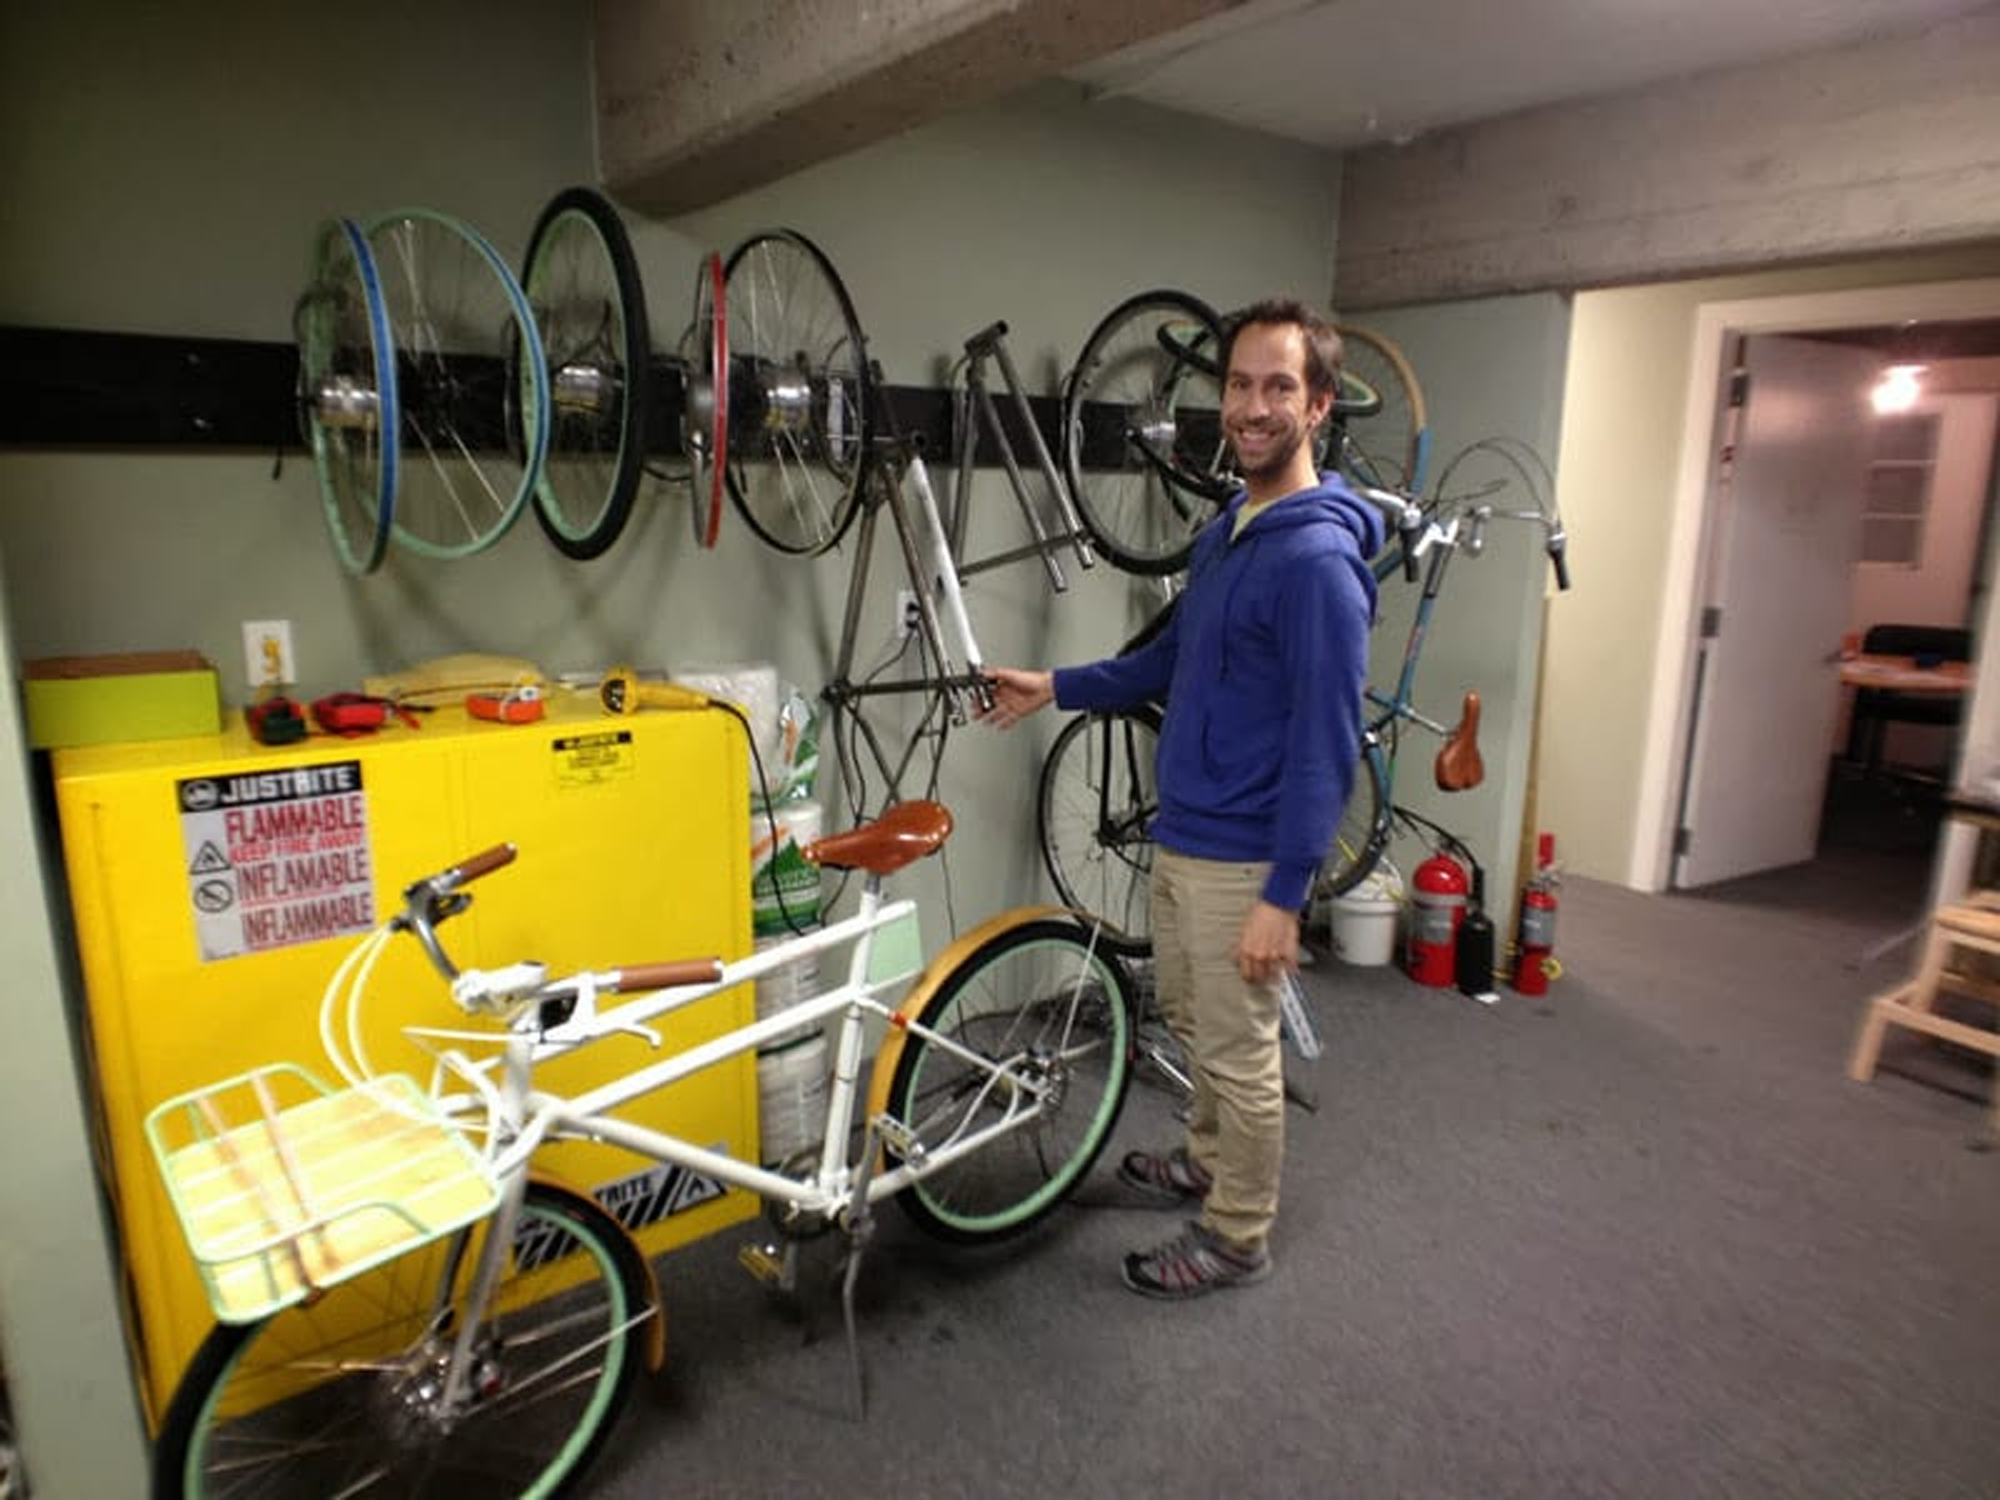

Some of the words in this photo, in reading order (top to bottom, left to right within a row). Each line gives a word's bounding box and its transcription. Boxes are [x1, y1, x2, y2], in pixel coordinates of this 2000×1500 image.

[220, 765, 354, 803] JUSTRITE
[224, 795, 364, 844] FLAMMABLE
[237, 848, 369, 901] INFLAMABLE
[242, 892, 373, 943] INFLAMMABLE
